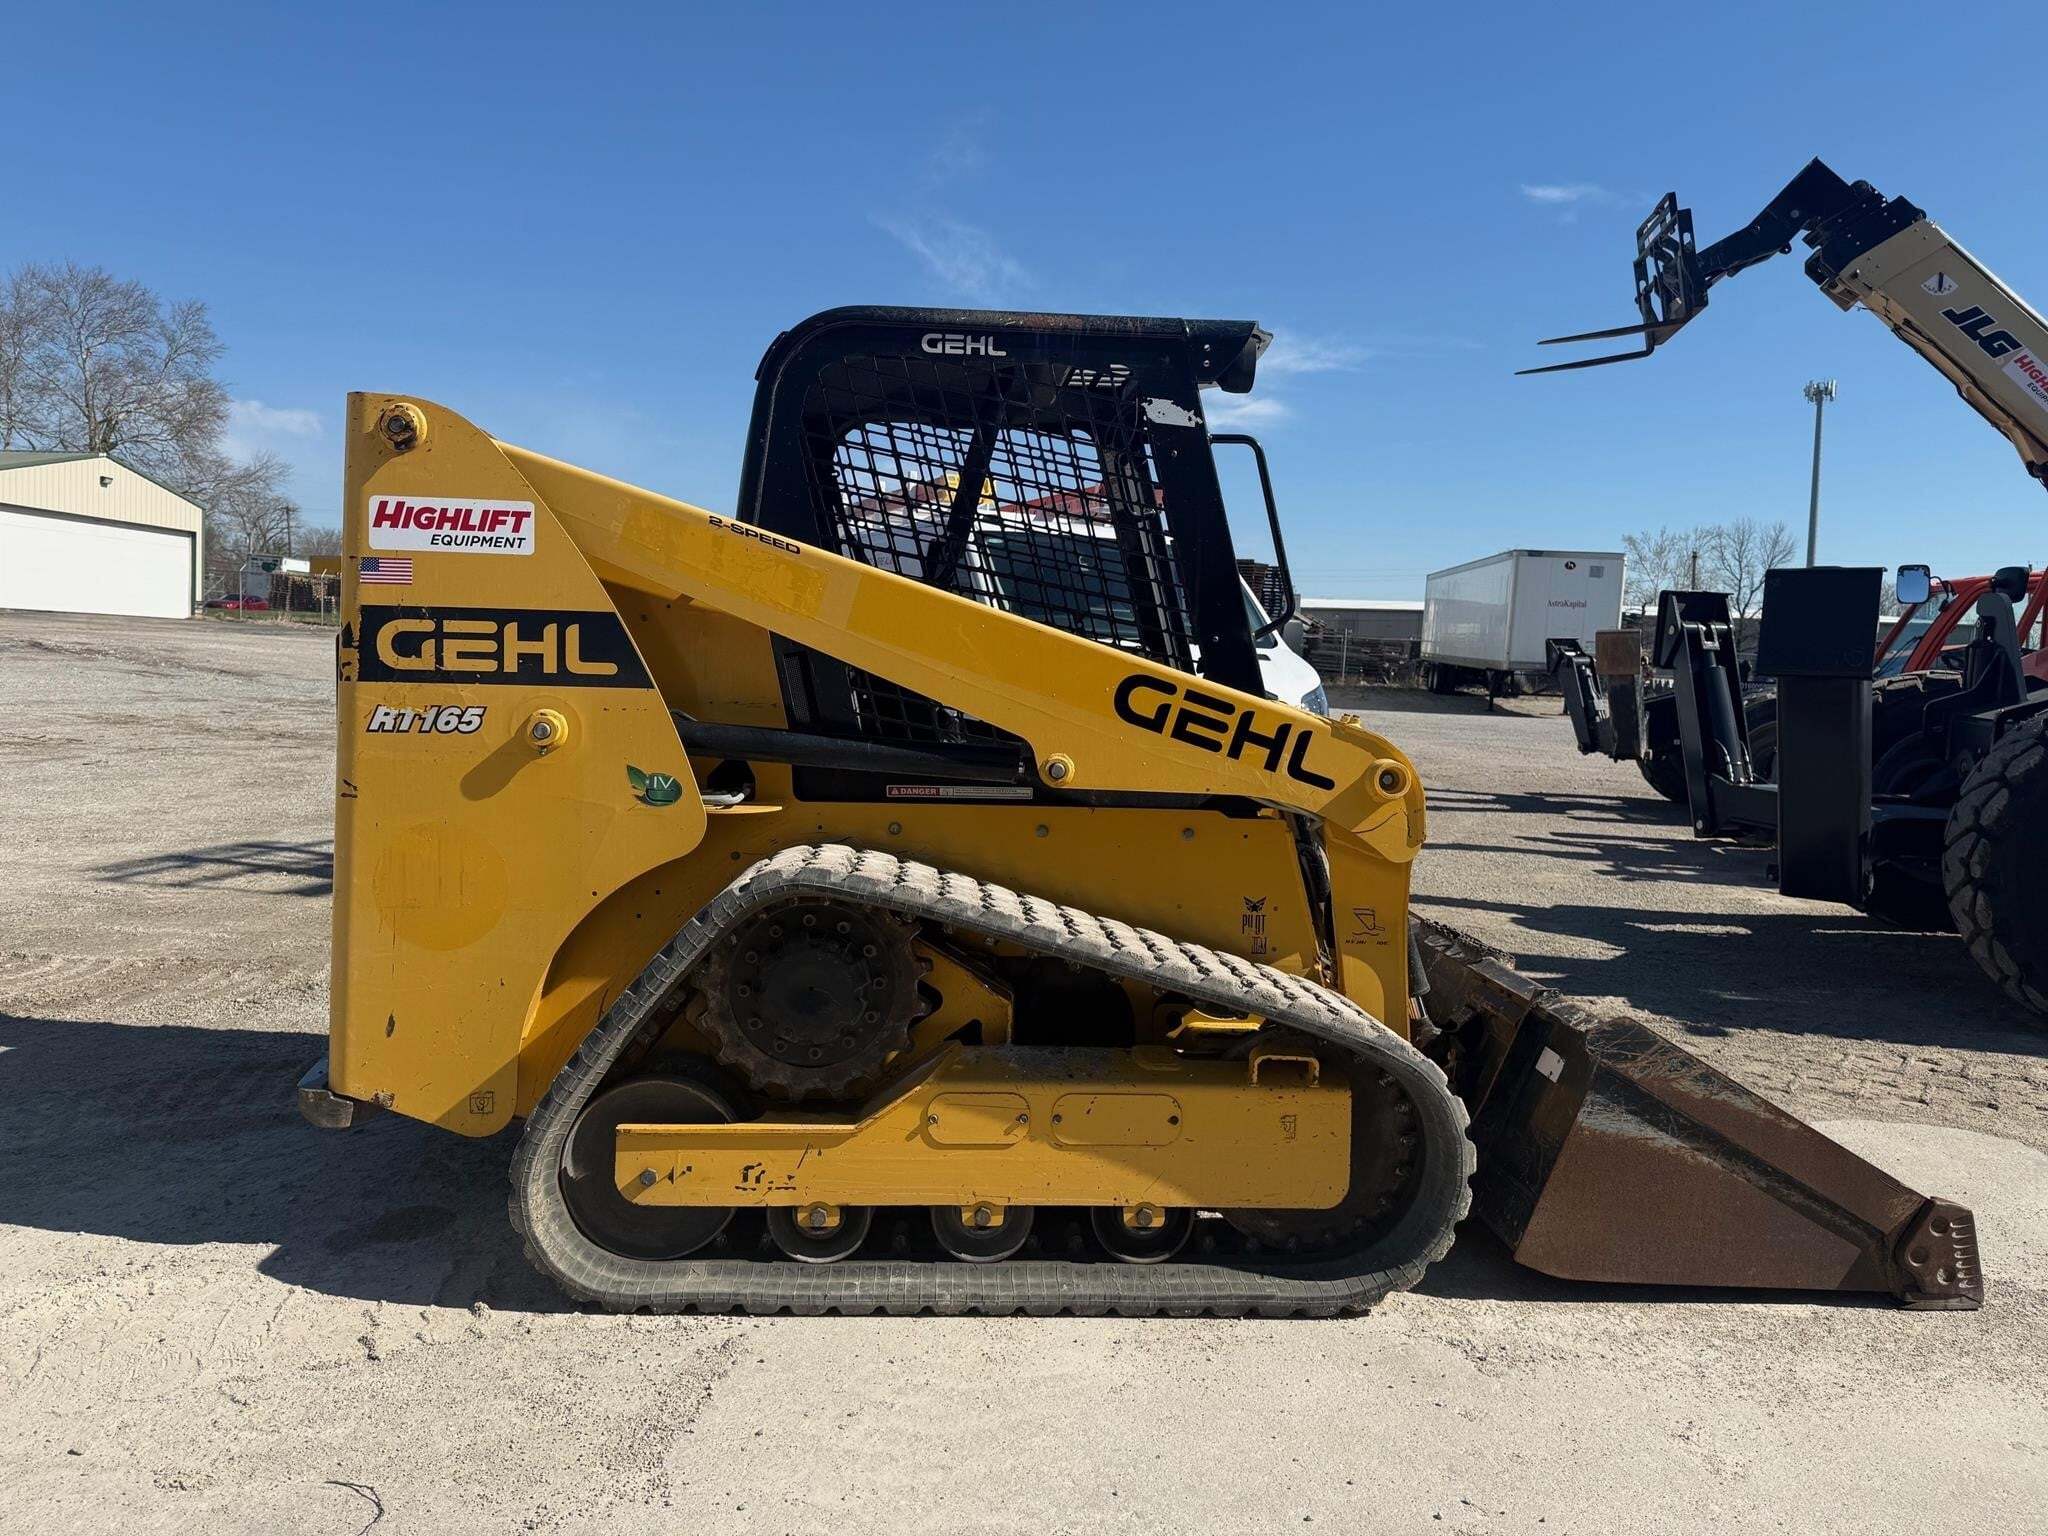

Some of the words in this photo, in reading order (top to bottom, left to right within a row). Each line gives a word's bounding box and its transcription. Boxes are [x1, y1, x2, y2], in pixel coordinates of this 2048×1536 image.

[921, 333, 1007, 357] GEHL
[1940, 305, 2024, 359] JLG
[2026, 382, 2048, 404] EQUIP
[372, 500, 532, 533] HIGHLIFT
[430, 534, 526, 549] EQUIPMENT
[709, 515, 801, 554] 2-SPEED
[376, 618, 619, 676] GEHL
[366, 704, 487, 734] RT165
[1114, 674, 1336, 791] GEHL
[900, 788, 937, 796] DANGER
